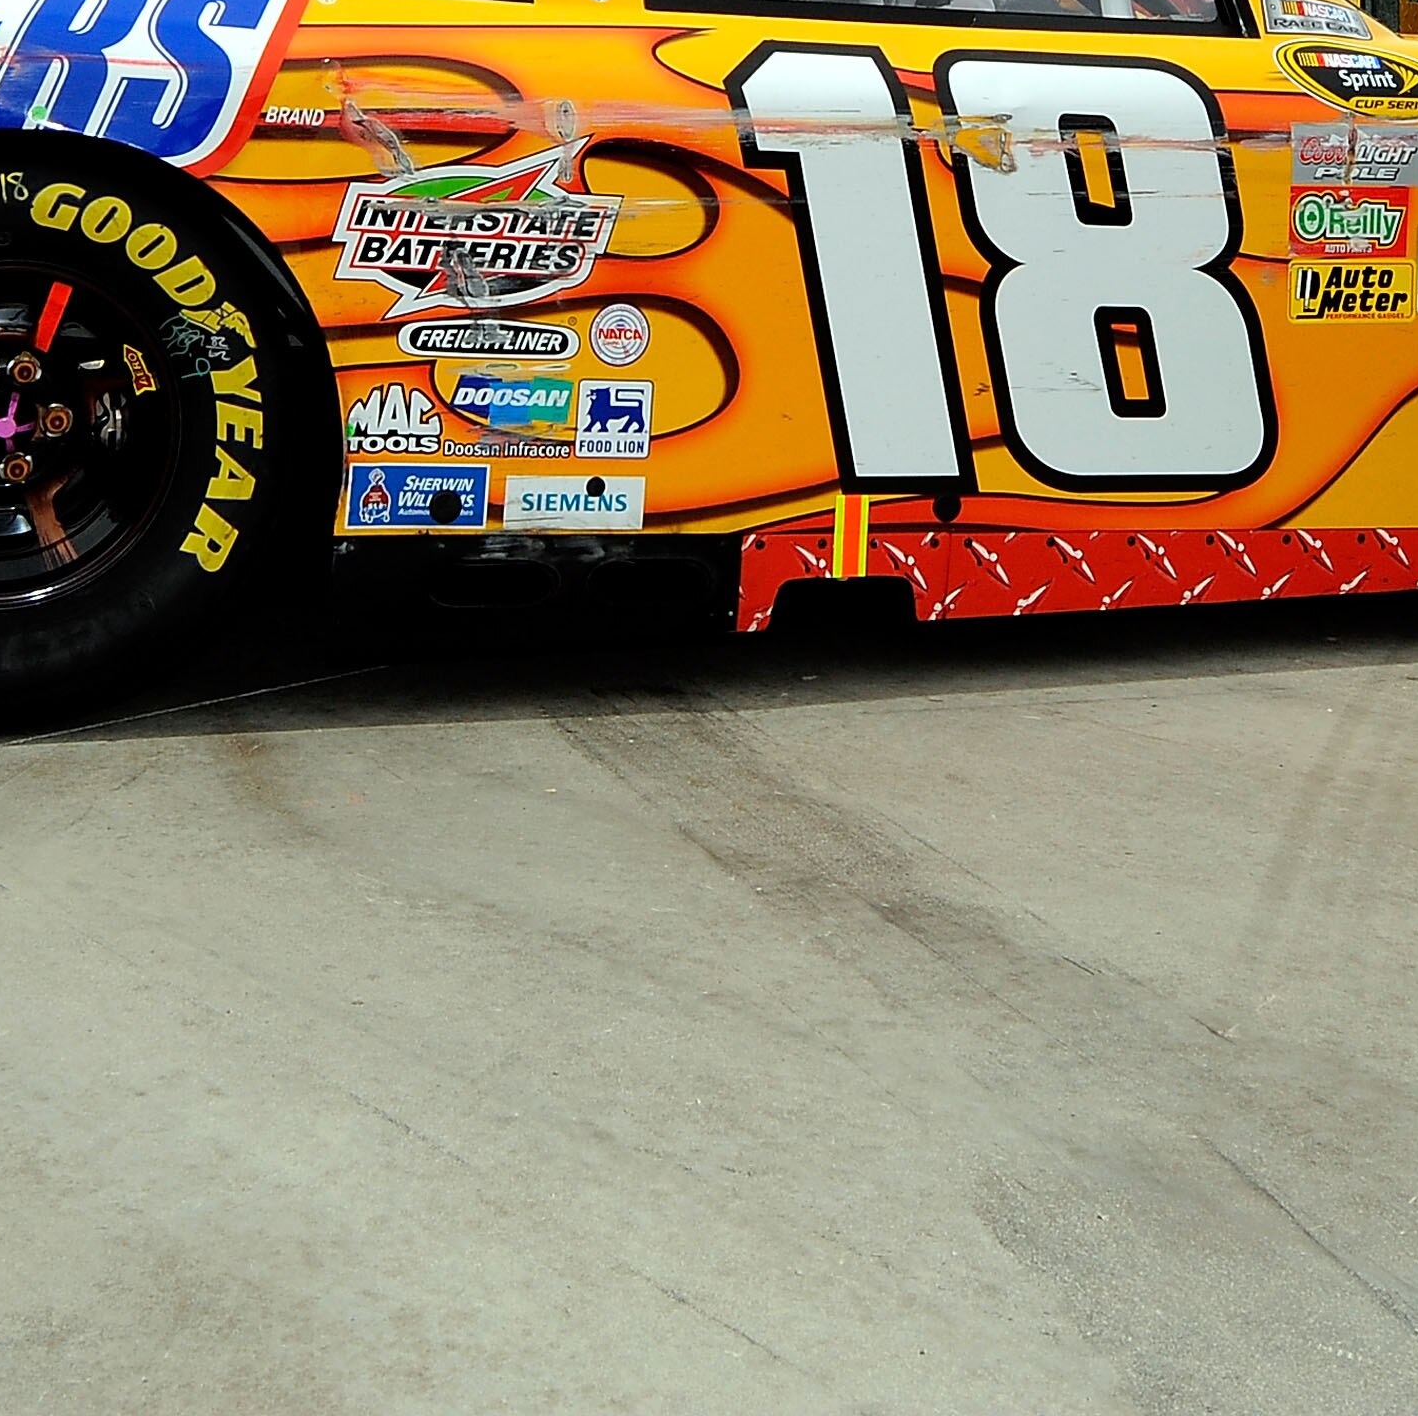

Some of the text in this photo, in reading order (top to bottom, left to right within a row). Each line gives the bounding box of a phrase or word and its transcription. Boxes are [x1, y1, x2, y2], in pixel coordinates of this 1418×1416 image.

[1302, 1, 1352, 23] NASCAR
[1273, 18, 1361, 35] RACE CAR
[1322, 52, 1382, 70] NASCAR
[1338, 69, 1398, 91] Sprint
[1354, 99, 1385, 110] CUP
[265, 105, 326, 127] BRAND
[1299, 134, 1418, 165] Coor LIGHT
[354, 198, 602, 239] INTERSTATE
[1324, 244, 1346, 253] AUTO
[724, 41, 1278, 494] 18
[1328, 265, 1394, 289] Auto
[1323, 289, 1408, 313] Meter
[597, 327, 644, 341] NATCA
[453, 386, 571, 408] DOOSAN
[348, 384, 442, 435] MAC
[347, 436, 440, 454] TOOLS
[444, 440, 571, 458] Doosan Infracore
[579, 439, 645, 454] FOOD LION
[402, 474, 475, 492] SHERWIN
[521, 492, 628, 513] SIEMENS
